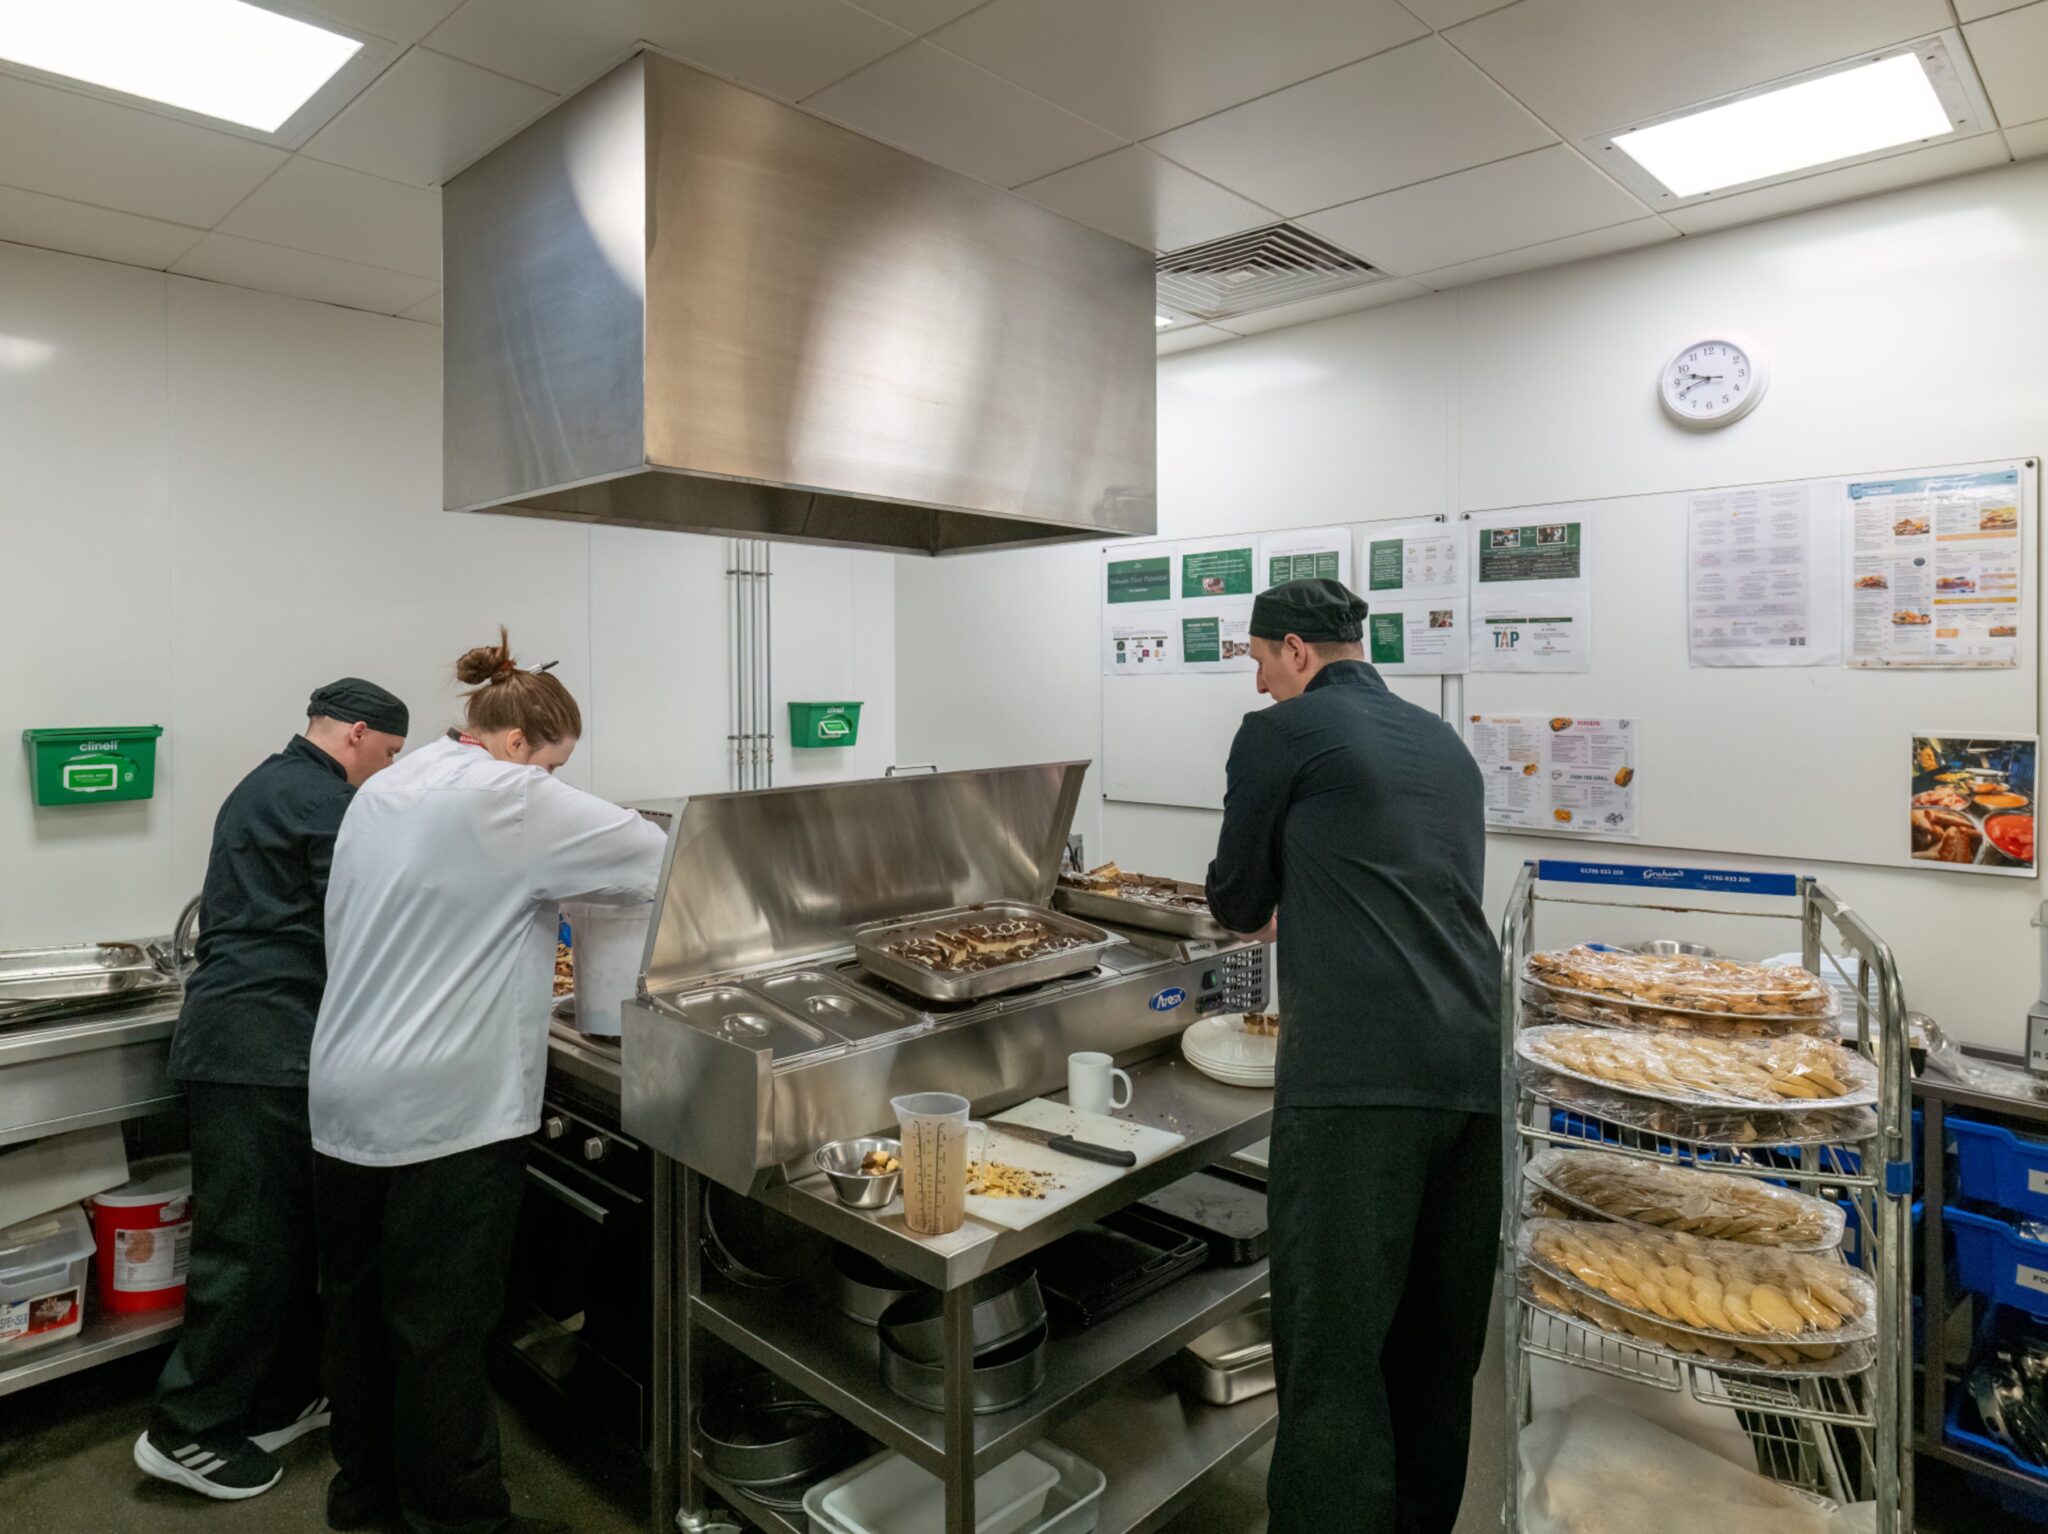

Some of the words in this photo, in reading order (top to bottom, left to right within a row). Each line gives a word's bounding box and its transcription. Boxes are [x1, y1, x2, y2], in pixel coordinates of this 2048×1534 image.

[1703, 346, 1715, 356] 12
[1722, 347, 1726, 356] 1
[1689, 353, 1698, 362] 11
[1732, 355, 1740, 364] 2
[1677, 364, 1690, 374] 10
[1738, 369, 1745, 378] 3
[1674, 378, 1681, 388] 9
[1733, 383, 1740, 391] 4
[1722, 394, 1729, 404] 5
[1691, 400, 1698, 408] 7
[1705, 400, 1713, 410] 6
[1493, 630, 1520, 648] TAP
